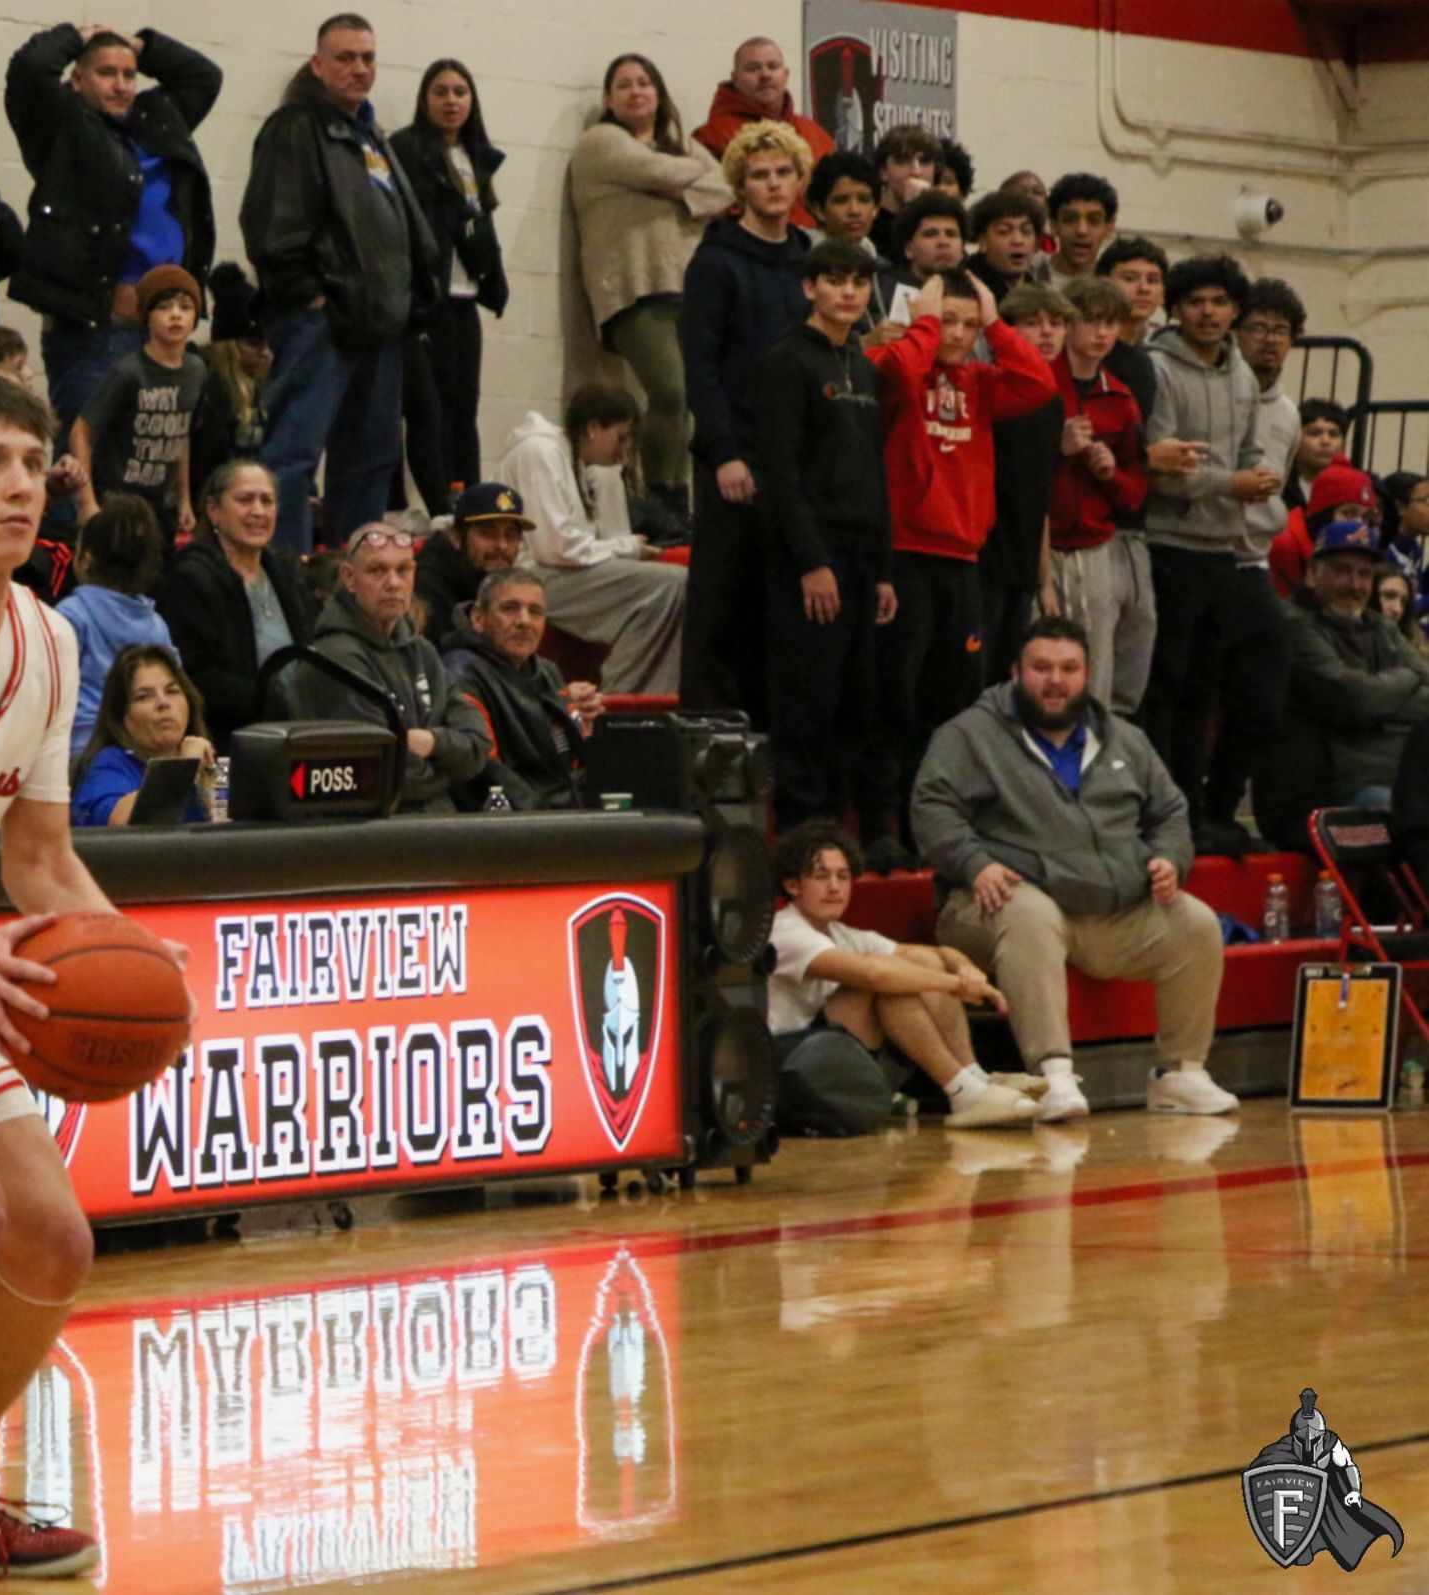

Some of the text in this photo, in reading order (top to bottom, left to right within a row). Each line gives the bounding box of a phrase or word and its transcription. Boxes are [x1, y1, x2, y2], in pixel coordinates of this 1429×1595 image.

[870, 27, 952, 86] VISITING
[310, 766, 357, 794] POSS.
[216, 904, 468, 1010] FAIRVIEW
[129, 1014, 552, 1194] WARRIORS
